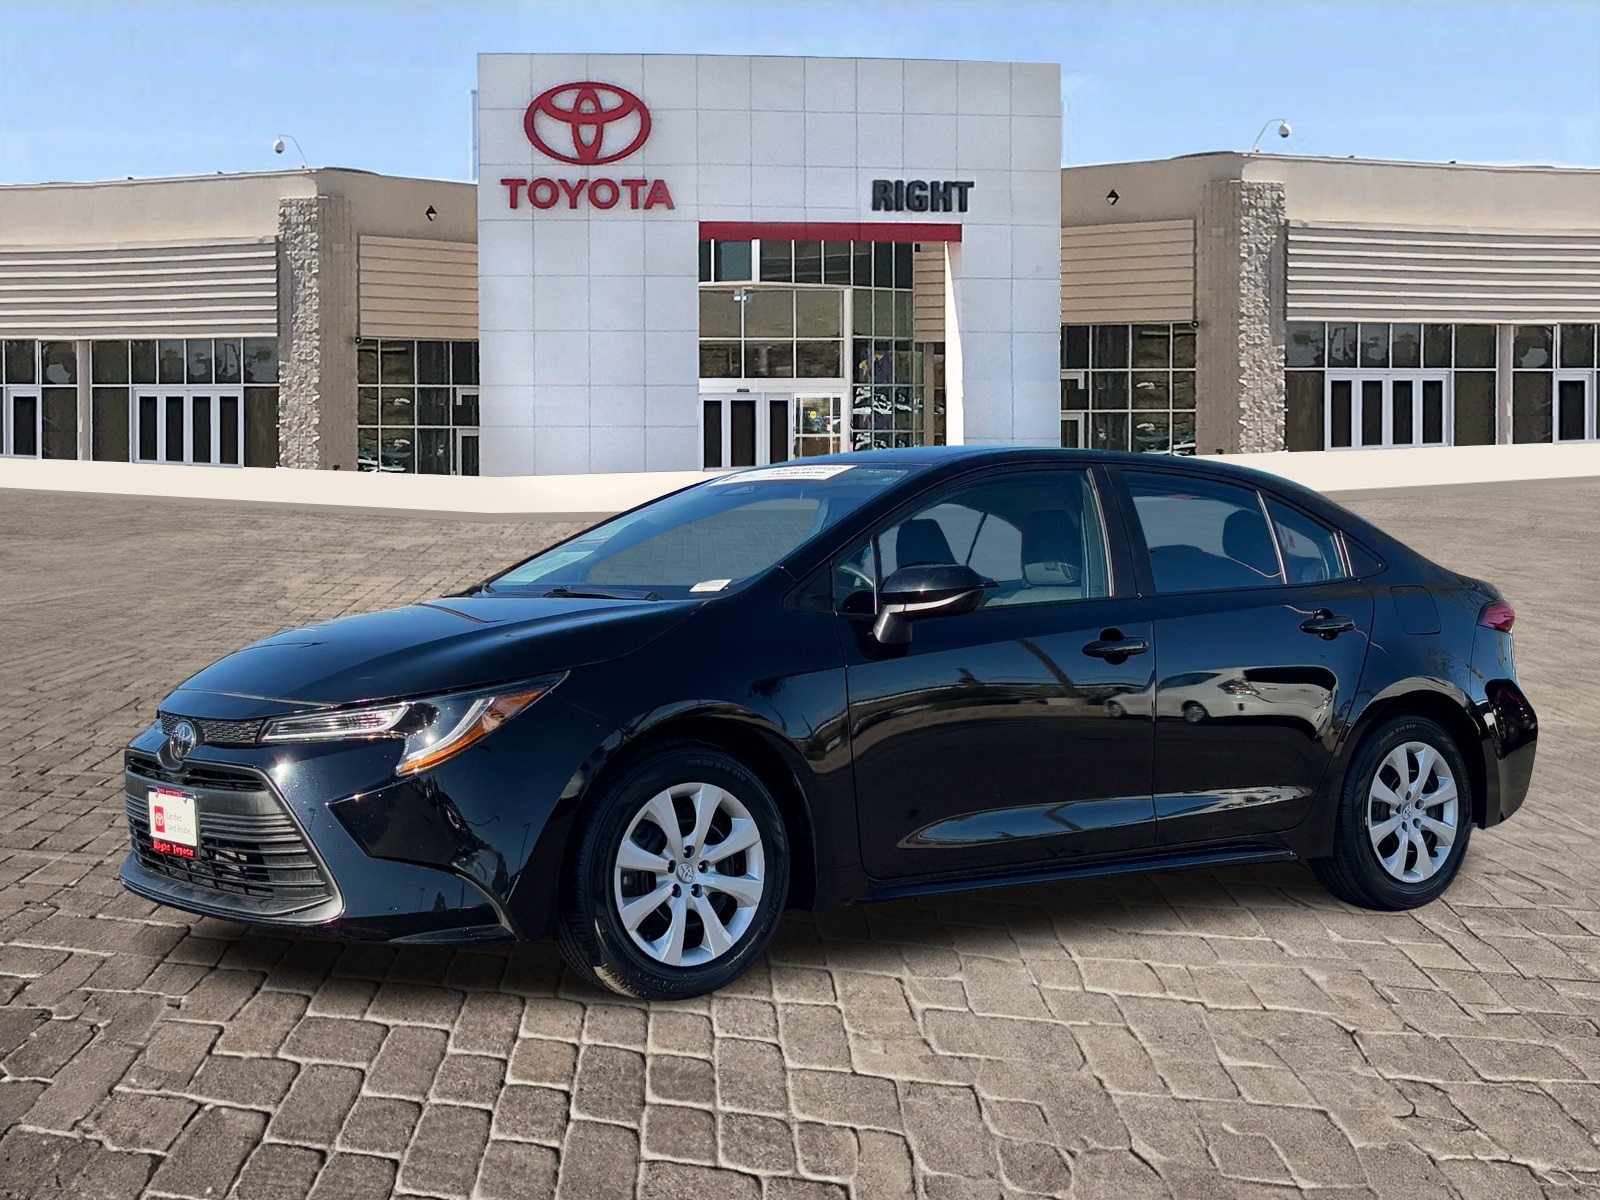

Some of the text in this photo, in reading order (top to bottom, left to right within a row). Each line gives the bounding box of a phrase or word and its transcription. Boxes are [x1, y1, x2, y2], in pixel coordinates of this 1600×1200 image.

[500, 178, 675, 210] TOYOTA
[871, 178, 974, 213] RIGHT
[173, 845, 194, 857] Toyota
